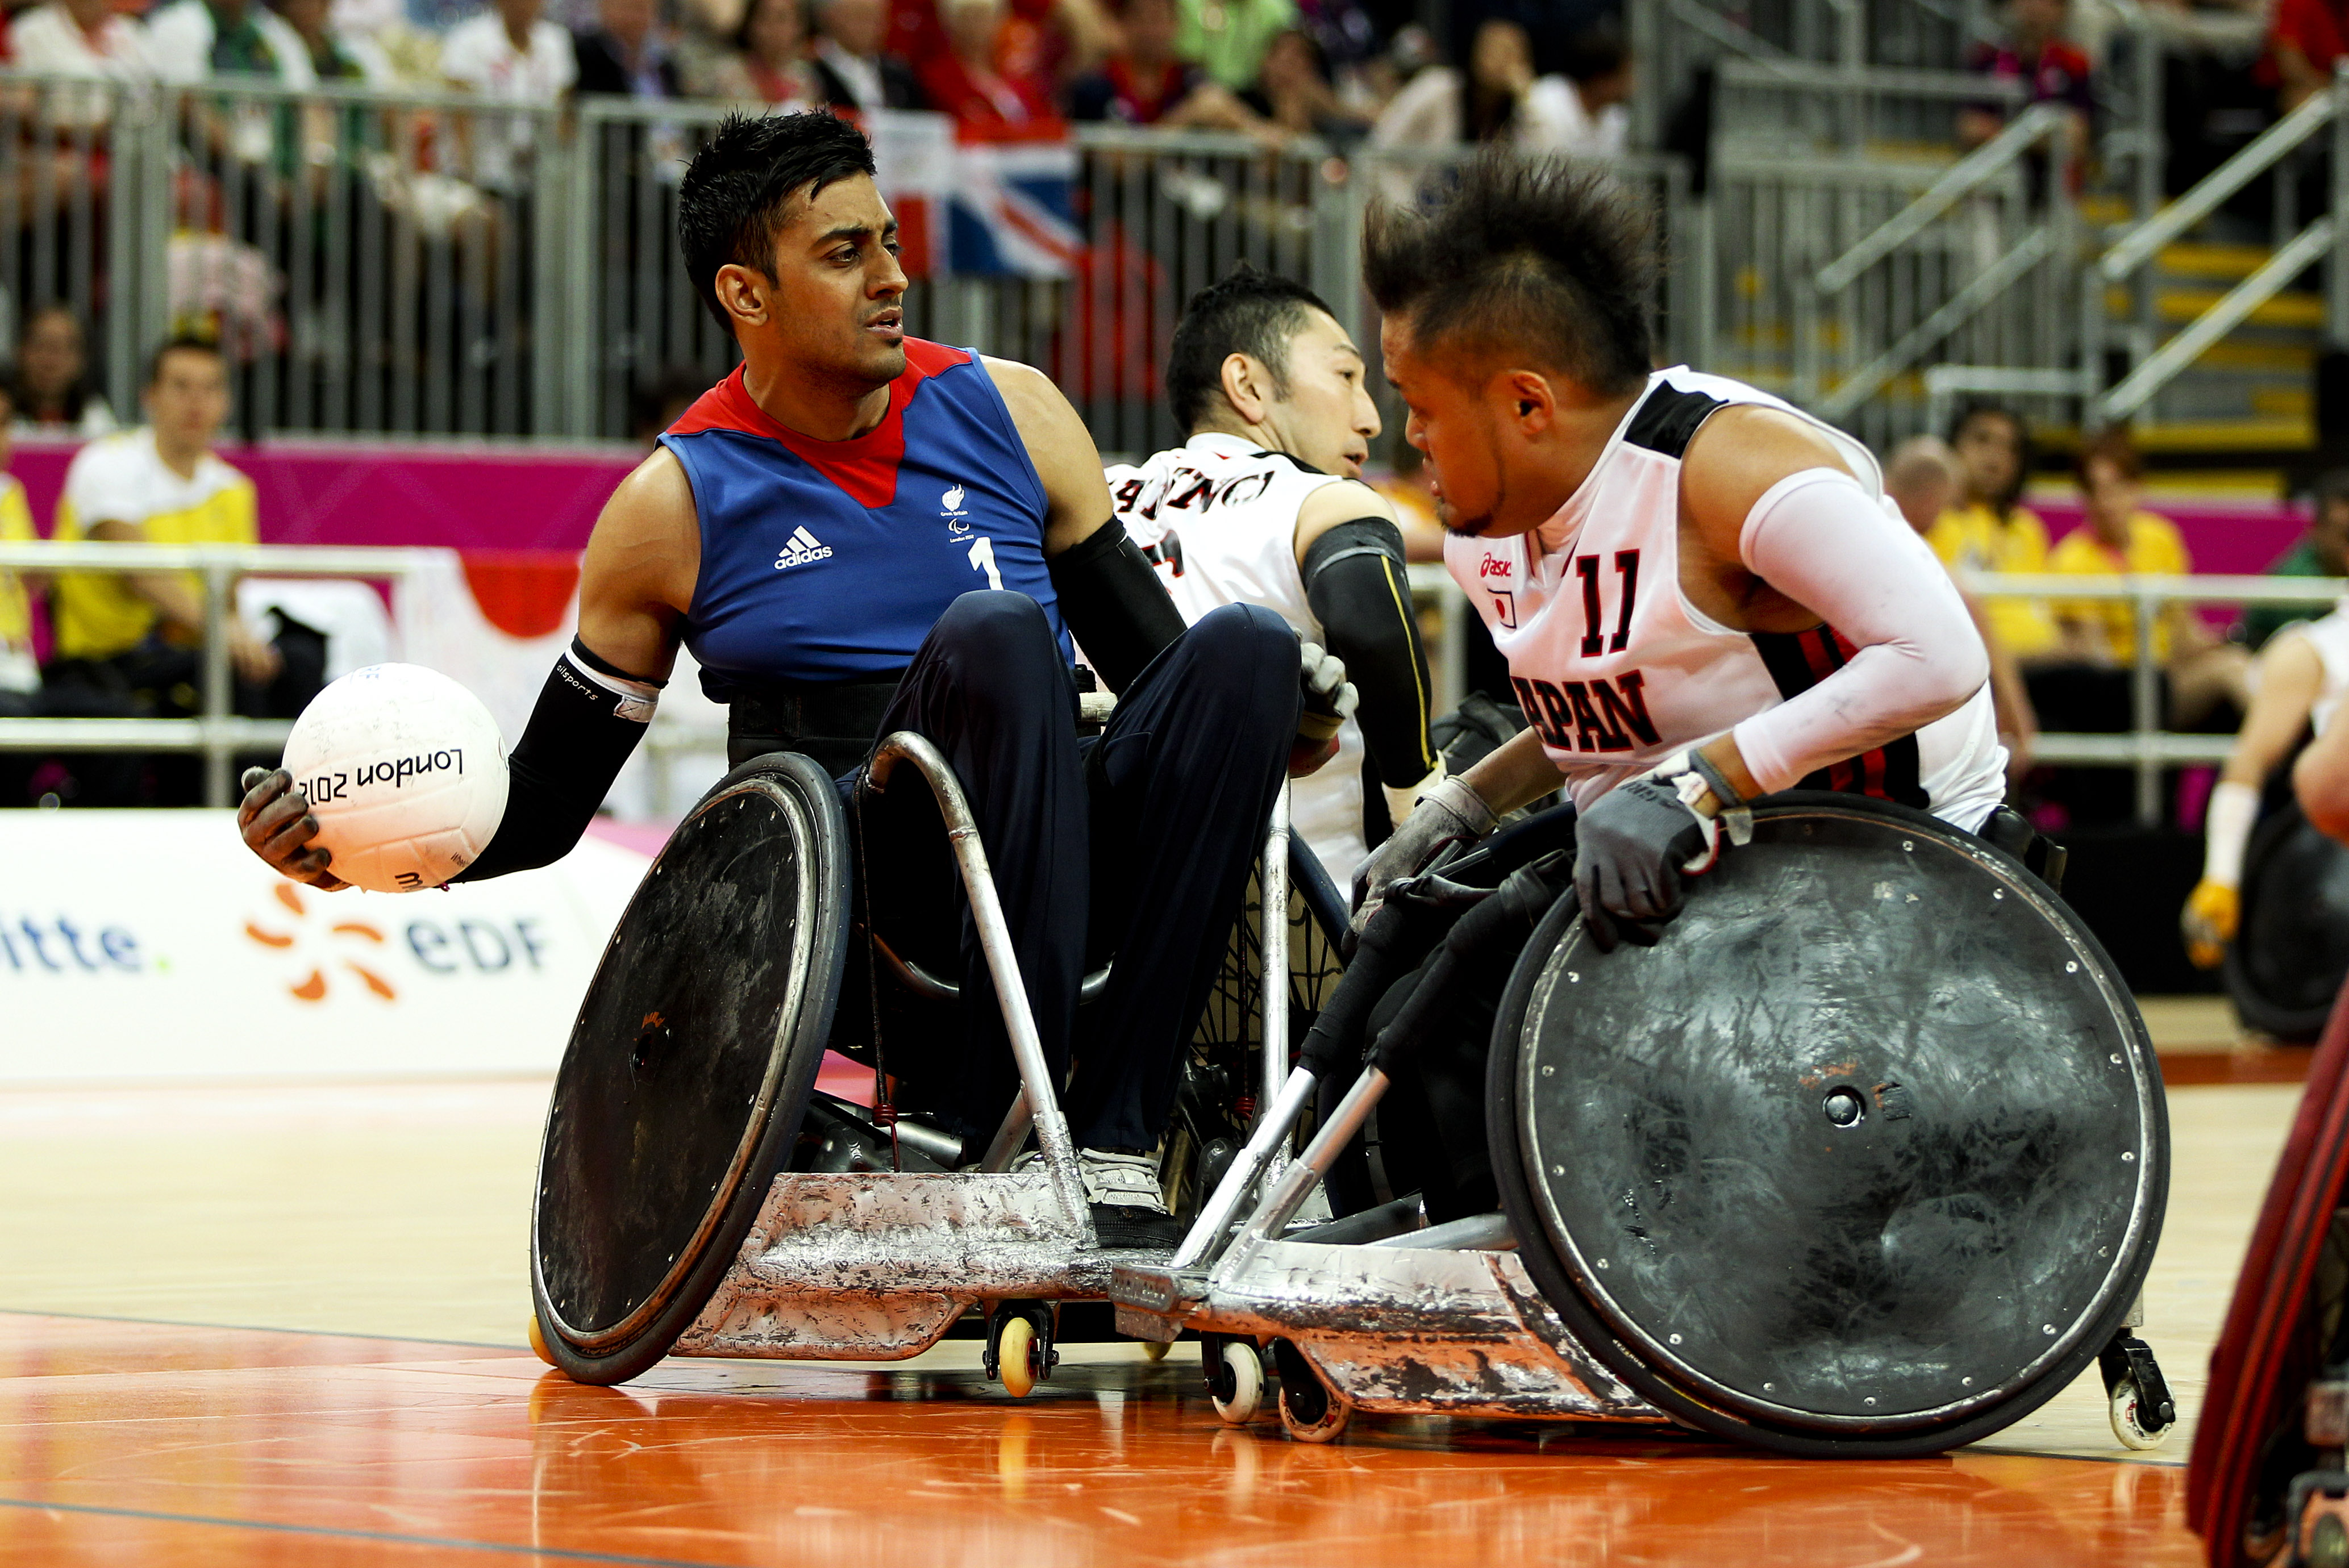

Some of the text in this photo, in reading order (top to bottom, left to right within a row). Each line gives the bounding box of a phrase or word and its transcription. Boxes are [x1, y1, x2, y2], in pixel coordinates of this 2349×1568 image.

[774, 546, 832, 569] adidas
[968, 537, 1004, 590] 1
[1576, 549, 1639, 658] 11
[1510, 669, 1663, 752] APAN
[299, 749, 463, 805] London 2012
